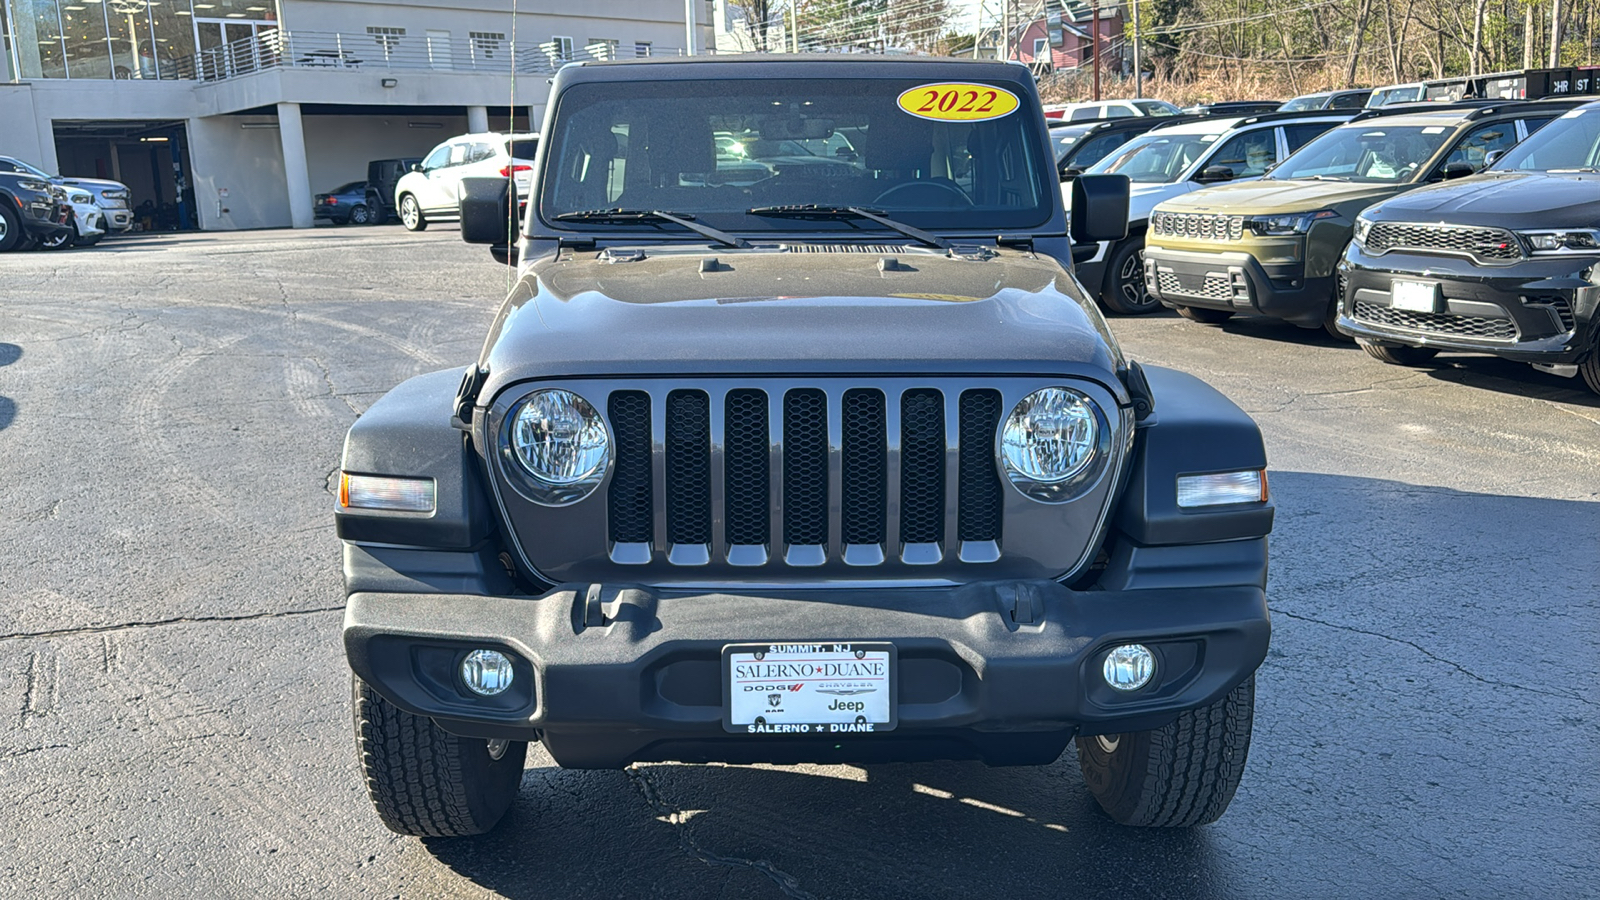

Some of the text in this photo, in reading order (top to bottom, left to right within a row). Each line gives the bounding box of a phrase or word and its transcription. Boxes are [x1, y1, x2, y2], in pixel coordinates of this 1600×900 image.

[916, 90, 998, 112] 2022
[833, 644, 851, 653] NJ
[736, 663, 884, 678] SALERNO DUANE
[743, 684, 796, 692] DODGE
[828, 698, 864, 713] Jeep
[747, 723, 874, 733] SALERNO DUANE
